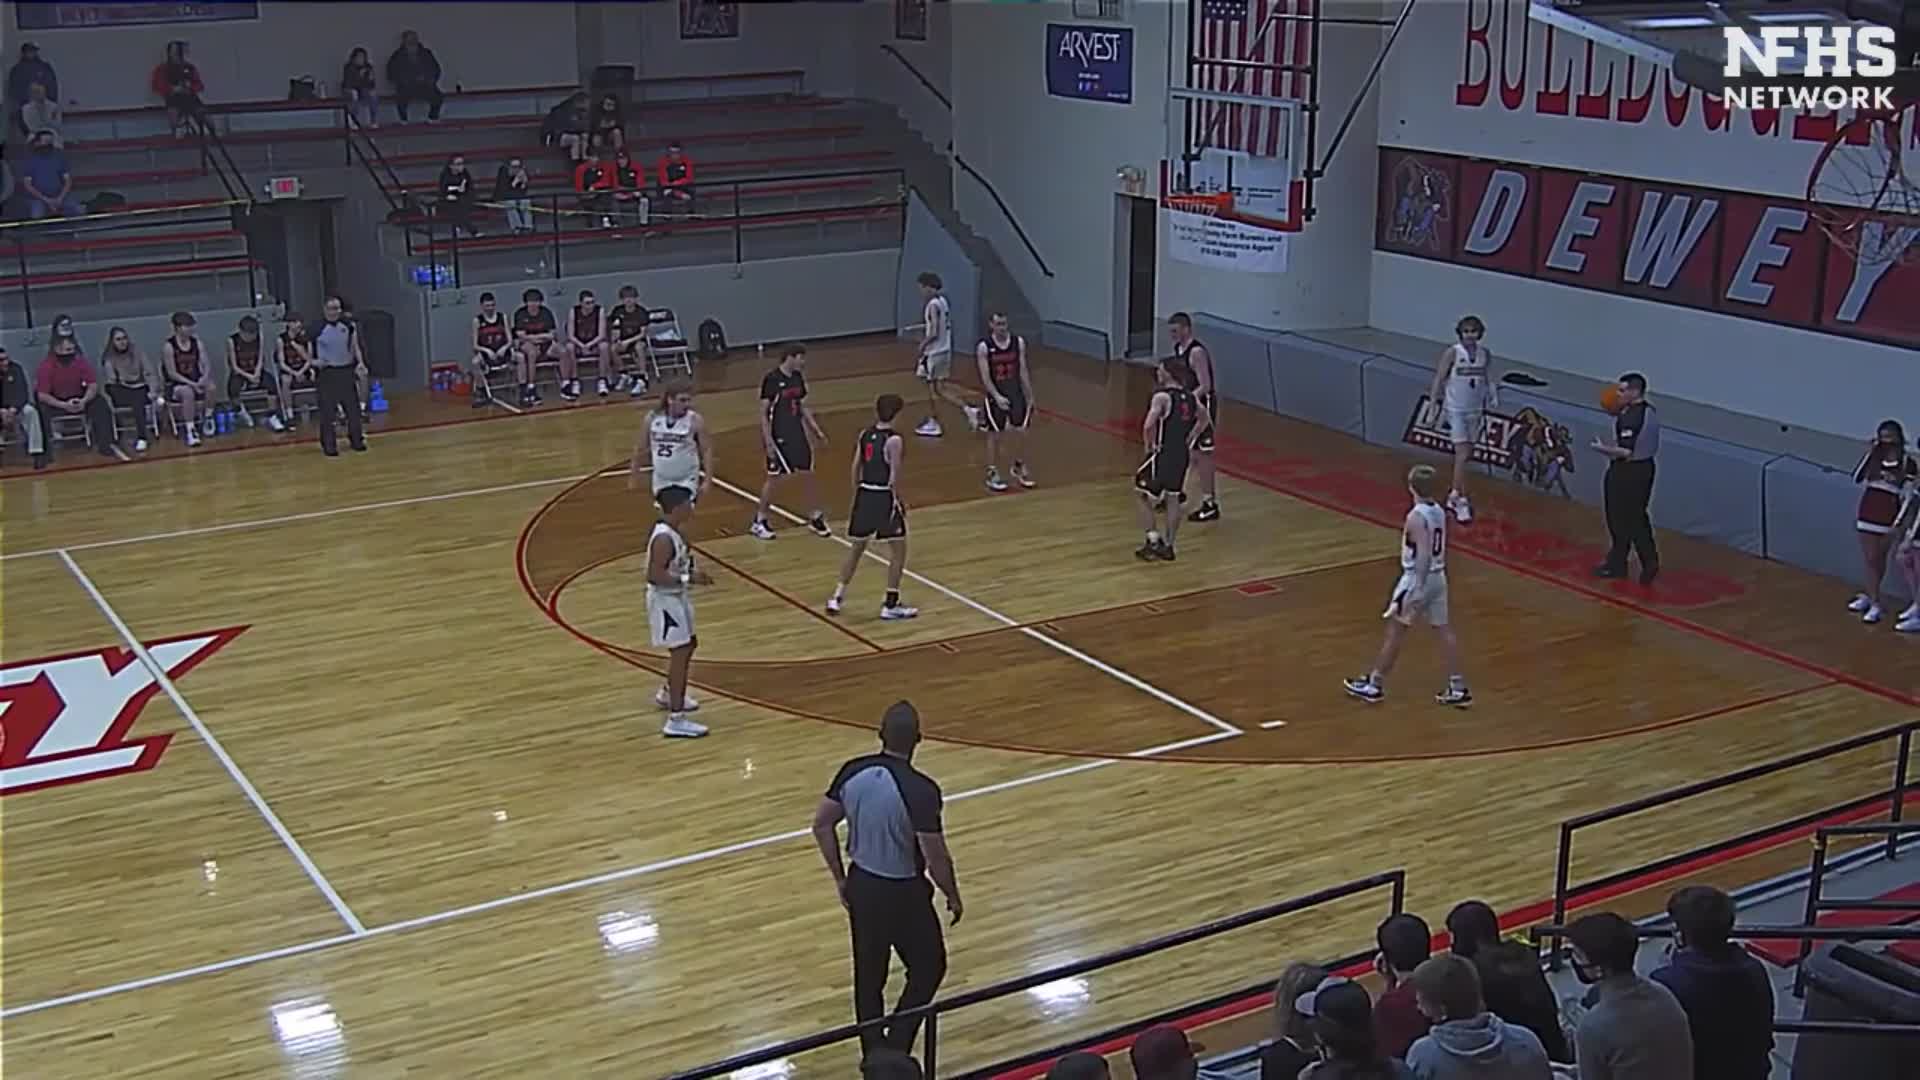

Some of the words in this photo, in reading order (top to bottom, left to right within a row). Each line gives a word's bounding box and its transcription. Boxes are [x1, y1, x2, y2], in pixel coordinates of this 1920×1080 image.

[1059, 31, 1120, 67] ARVEST
[1463, 169, 1920, 324] DEWEY
[657, 443, 674, 458] 25
[1432, 527, 1443, 557] 0
